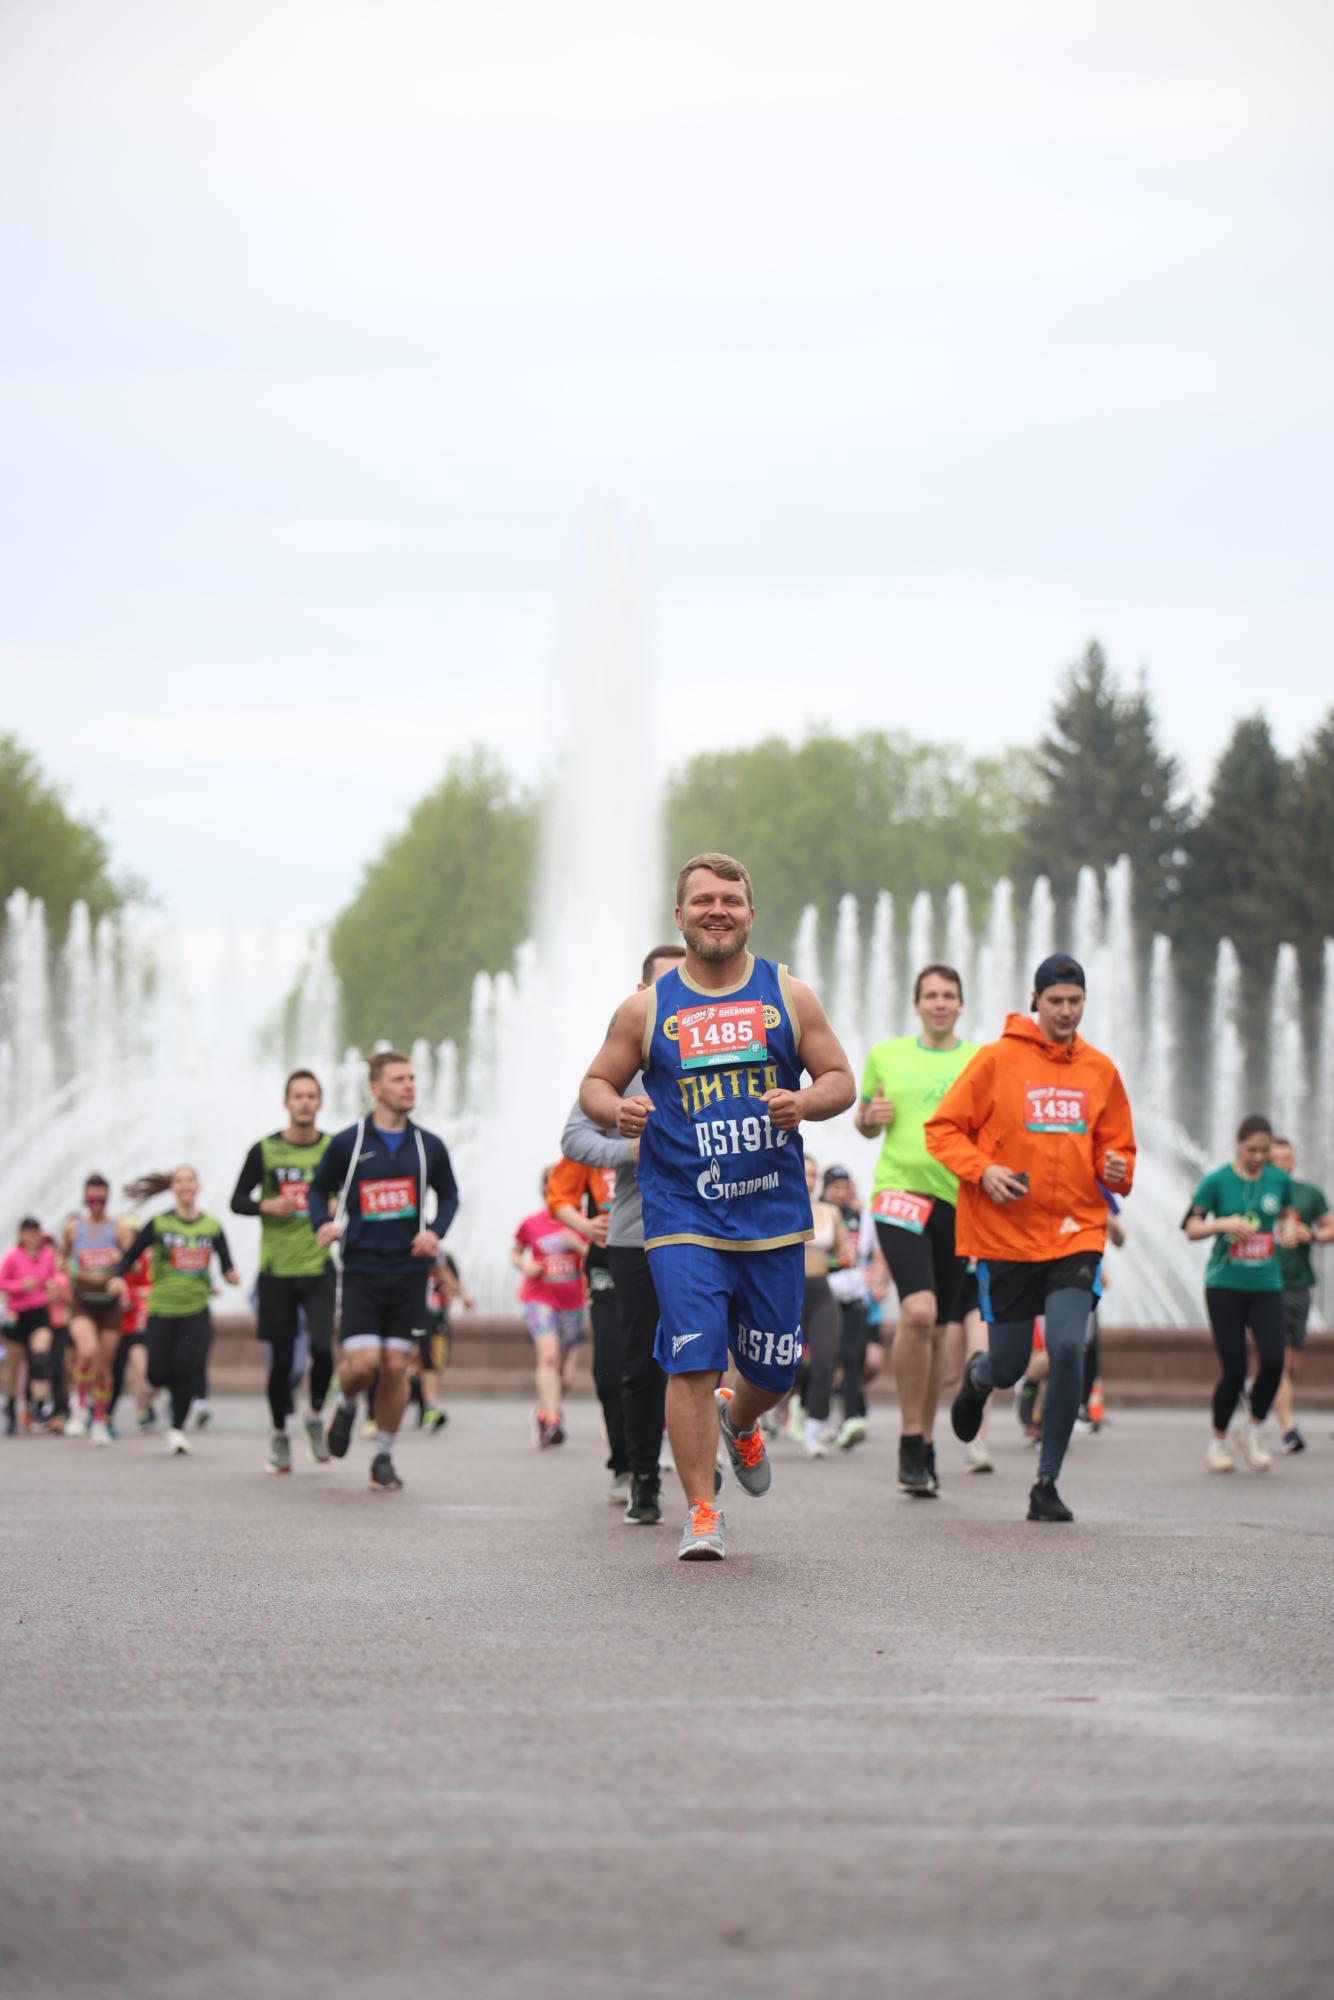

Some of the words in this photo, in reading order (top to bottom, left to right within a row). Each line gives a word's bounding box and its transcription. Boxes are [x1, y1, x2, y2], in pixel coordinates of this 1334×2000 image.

[718, 1006, 756, 1017] ДНЕВНИК
[688, 1020, 754, 1048] 1485
[1031, 1099, 1081, 1119] 1438
[725, 1171, 780, 1199] ГАЗПРОМ
